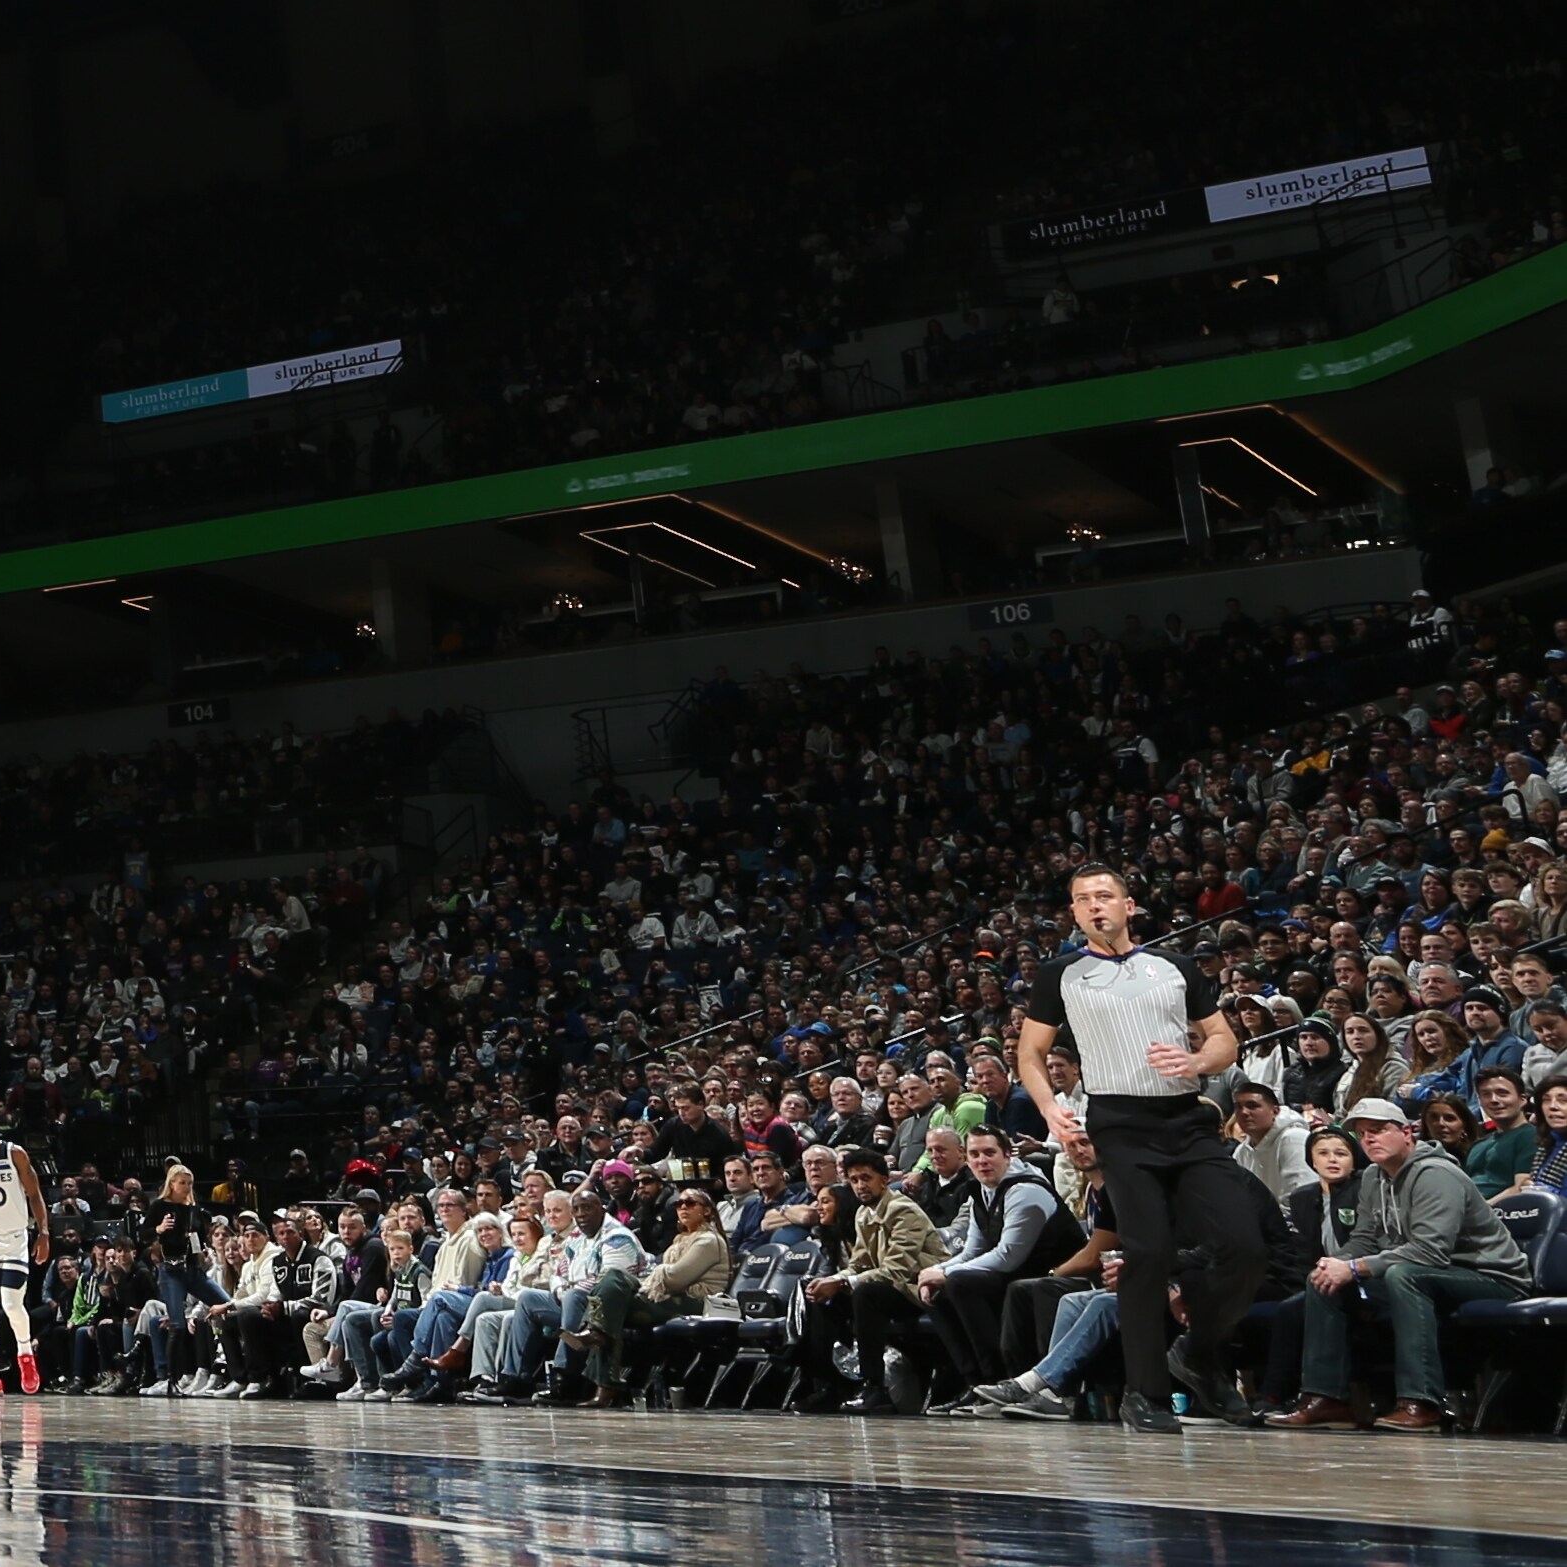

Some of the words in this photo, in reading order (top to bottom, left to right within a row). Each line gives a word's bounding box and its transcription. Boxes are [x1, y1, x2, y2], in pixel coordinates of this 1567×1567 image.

[1245, 157, 1394, 201] slumberland
[1028, 200, 1167, 243] slumberland
[275, 348, 379, 380] slumberland
[121, 378, 220, 409] slumberland
[990, 603, 1031, 624] 106
[184, 704, 214, 723] 104
